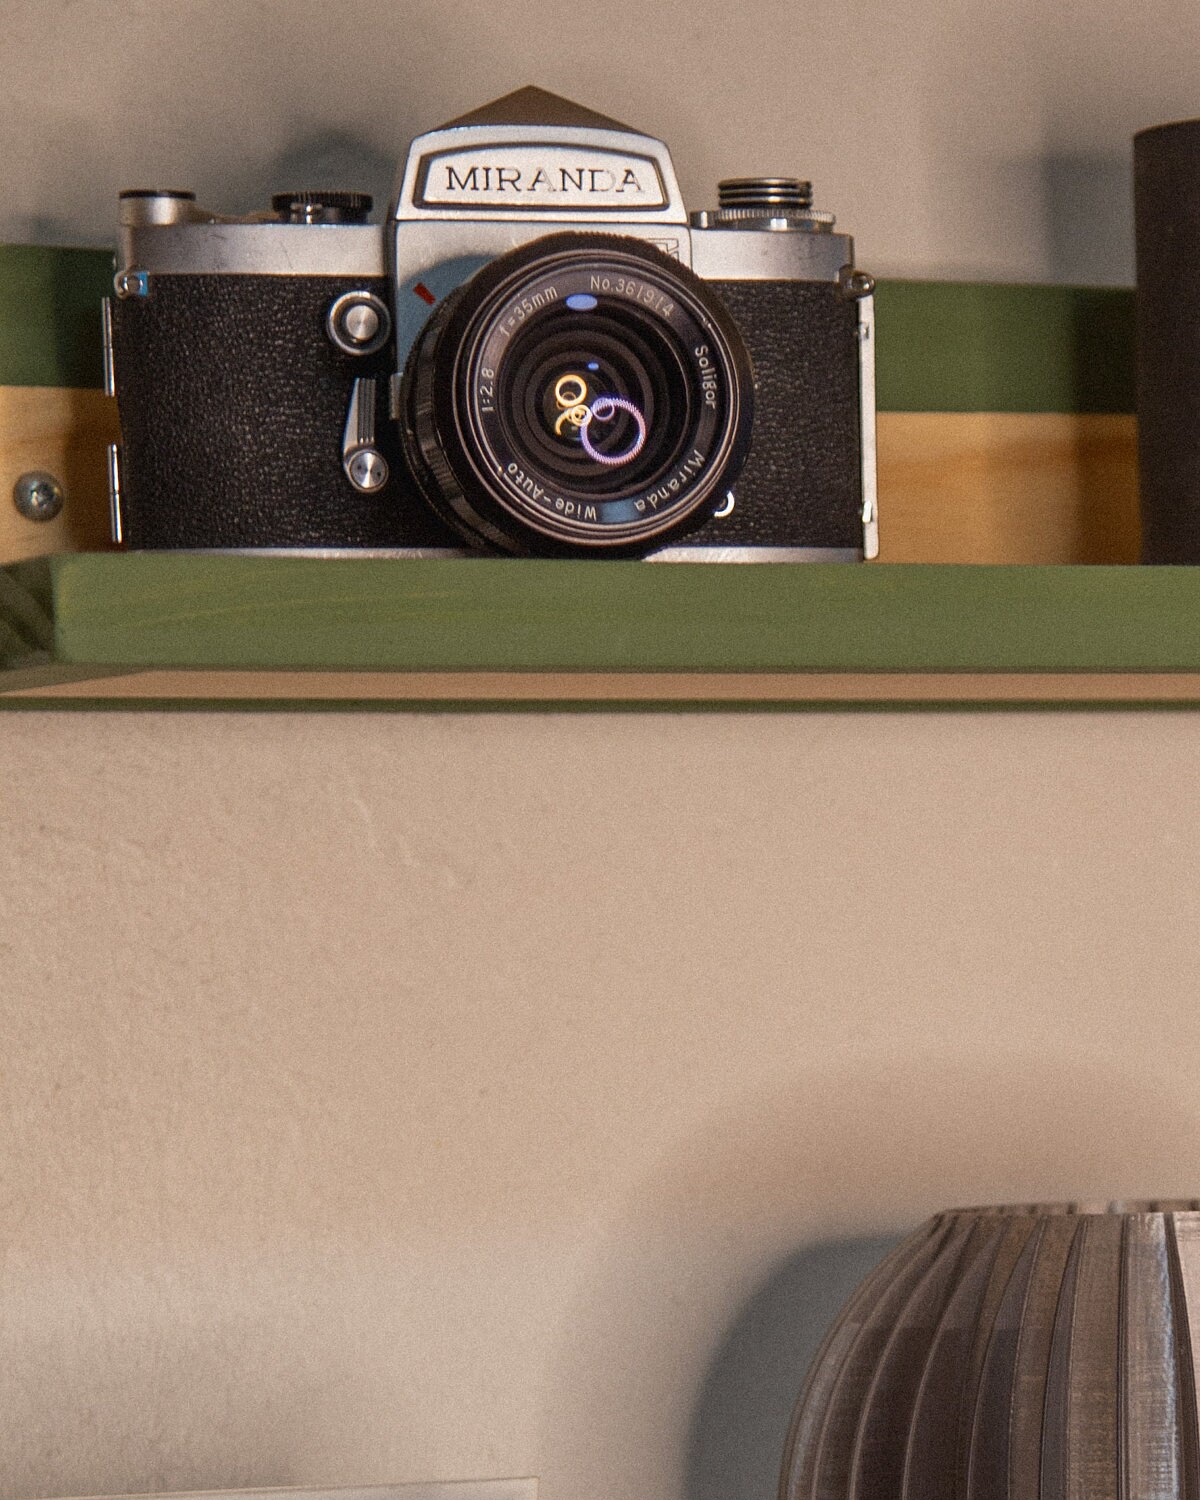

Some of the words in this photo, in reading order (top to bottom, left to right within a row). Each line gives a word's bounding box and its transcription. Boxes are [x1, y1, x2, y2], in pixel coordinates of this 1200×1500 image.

[445, 166, 644, 193] MIRANDA
[480, 367, 495, 413] 1:2.8
[694, 344, 718, 409] Soligor
[633, 449, 706, 512] Miranda
